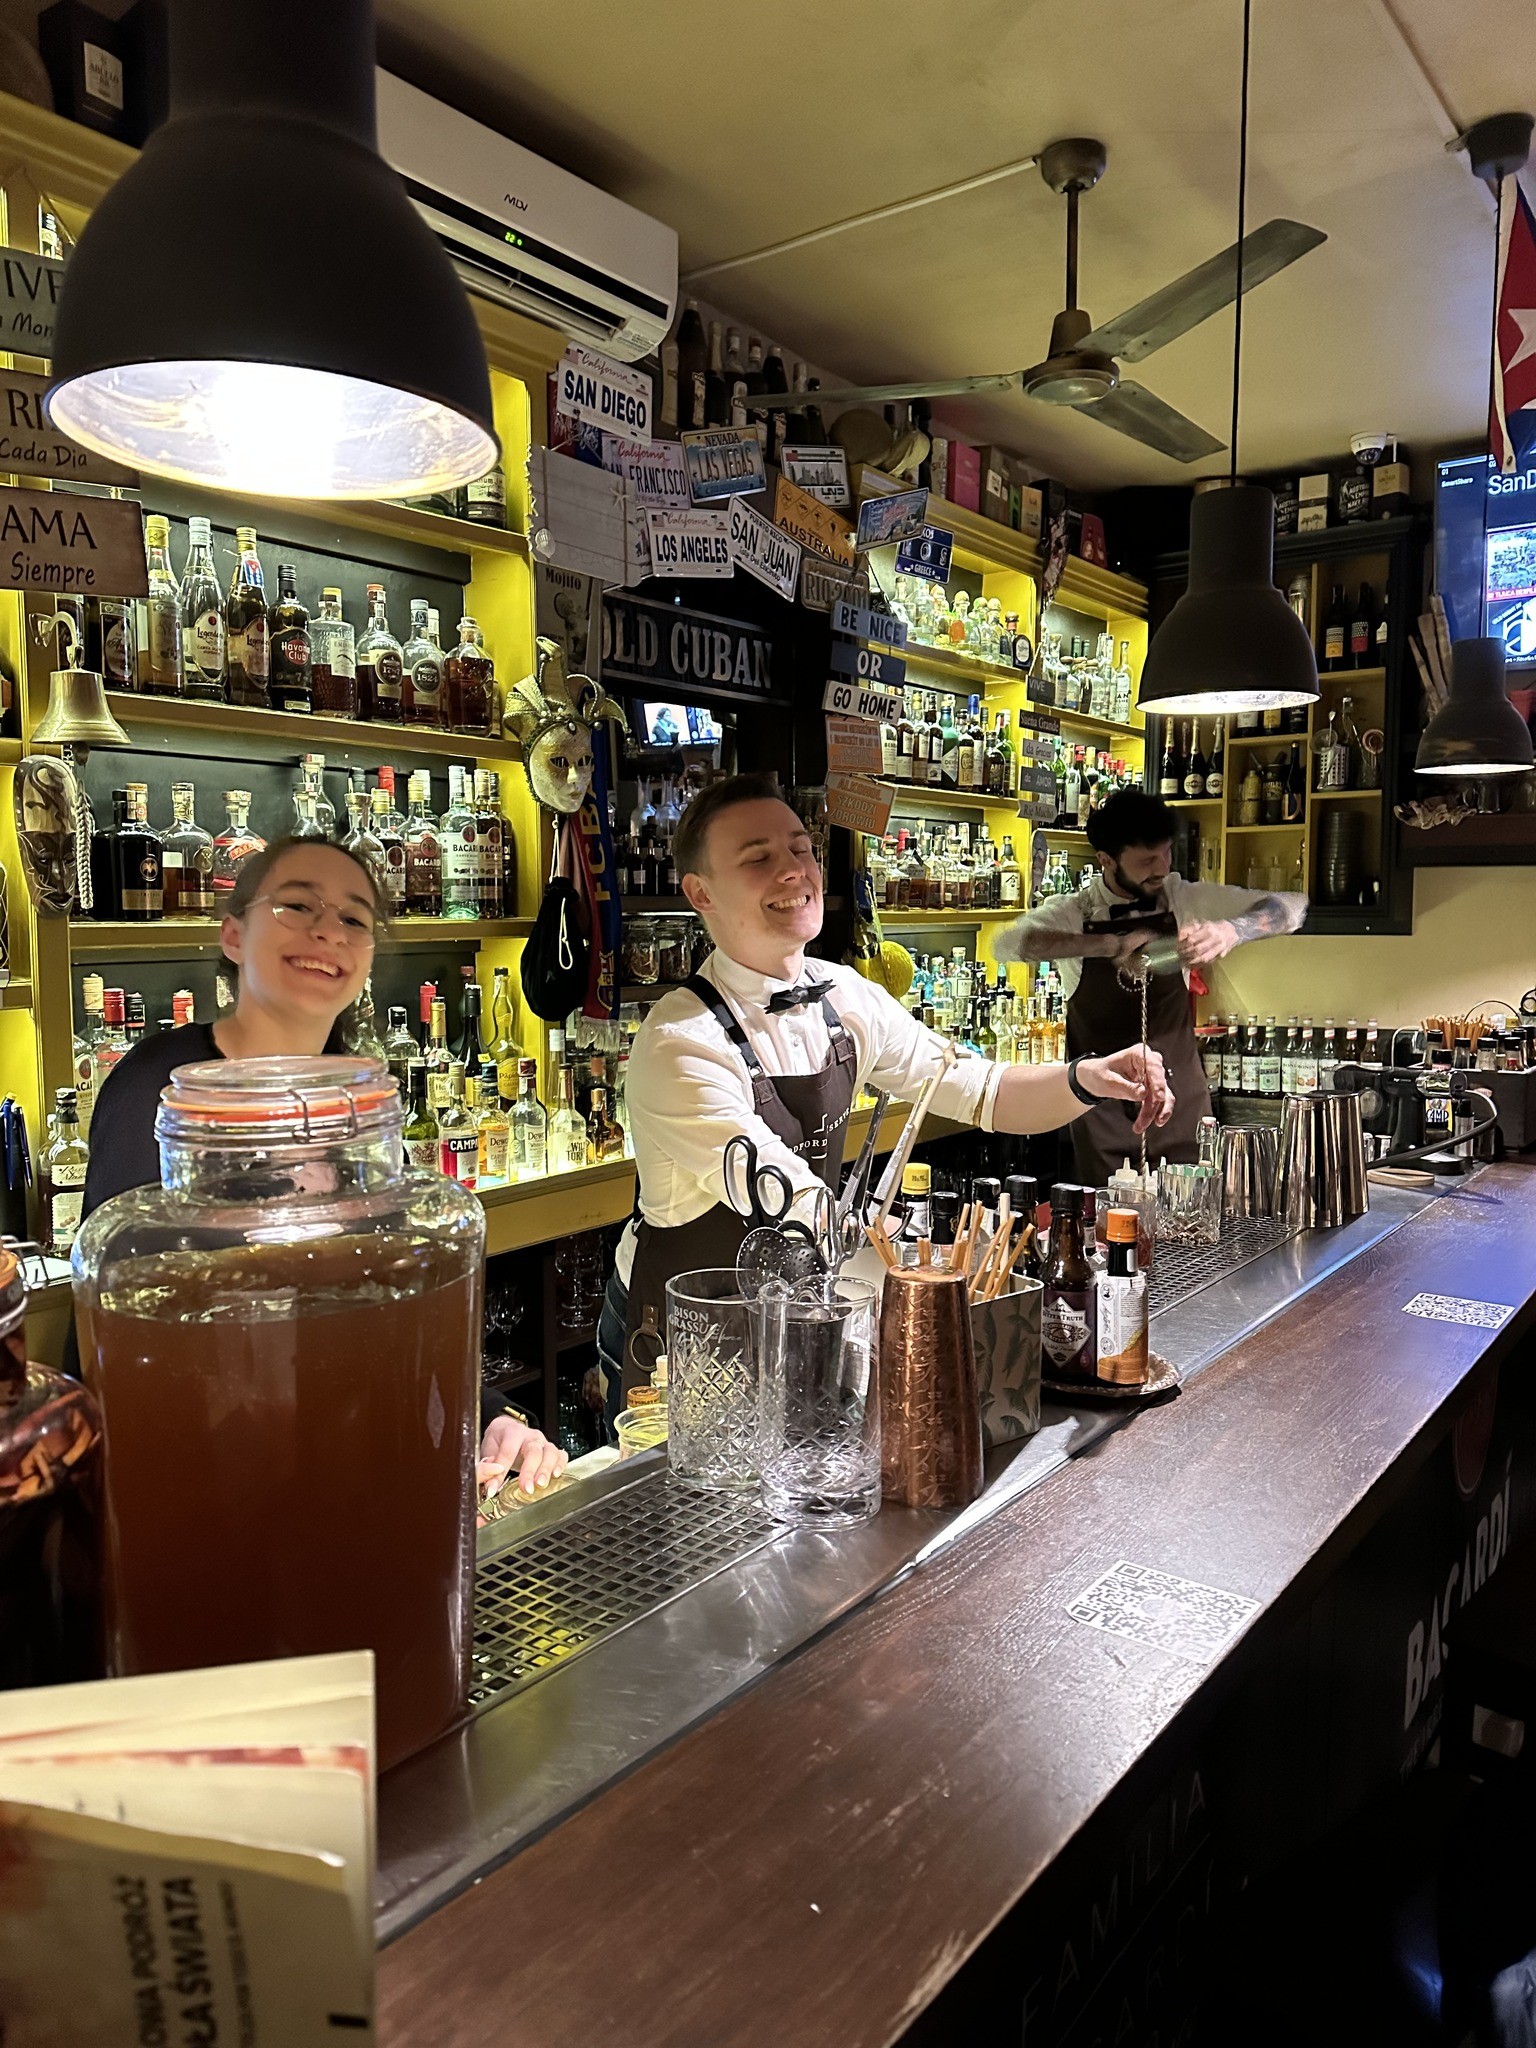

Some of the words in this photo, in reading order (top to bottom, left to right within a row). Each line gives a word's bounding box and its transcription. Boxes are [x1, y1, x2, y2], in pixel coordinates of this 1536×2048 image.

[582, 352, 634, 385] California
[10, 388, 44, 431] RI
[564, 369, 597, 409] SAN
[601, 384, 647, 430] DIEGO
[0, 437, 47, 464] Cada
[618, 440, 672, 463] California
[704, 432, 741, 448] NEVADA
[697, 450, 720, 483] LAS
[721, 446, 755, 480] VEGAS
[629, 464, 687, 497] FRANCISCO
[1, 504, 98, 550] AMA
[667, 512, 713, 528] California
[655, 534, 678, 562] LOS
[681, 536, 728, 564] ANGELES
[730, 512, 759, 555] SAN
[763, 539, 795, 582] JUAN
[779, 516, 850, 566] AUSTRALIA
[11, 551, 96, 592] Siempre
[545, 567, 582, 591] Mojito
[914, 563, 933, 576] GREECE
[840, 604, 858, 631] BE
[868, 615, 901, 646] NICE
[288, 649, 308, 662] Club
[670, 621, 772, 690] CUBAN
[857, 650, 883, 679] OR
[1029, 678, 1046, 693] VIVE
[833, 686, 852, 711] GO
[858, 692, 898, 721] HOME
[1038, 716, 1060, 732] Grande
[830, 807, 876, 829] ZDROWIU
[837, 794, 877, 814] SZKODZI
[452, 844, 478, 852] BACAR
[449, 1138, 478, 1152] CAMP
[789, 1138, 829, 1154] DFORD
[673, 1305, 709, 1324] BISON
[161, 1876, 212, 1996] ŚWIATA
